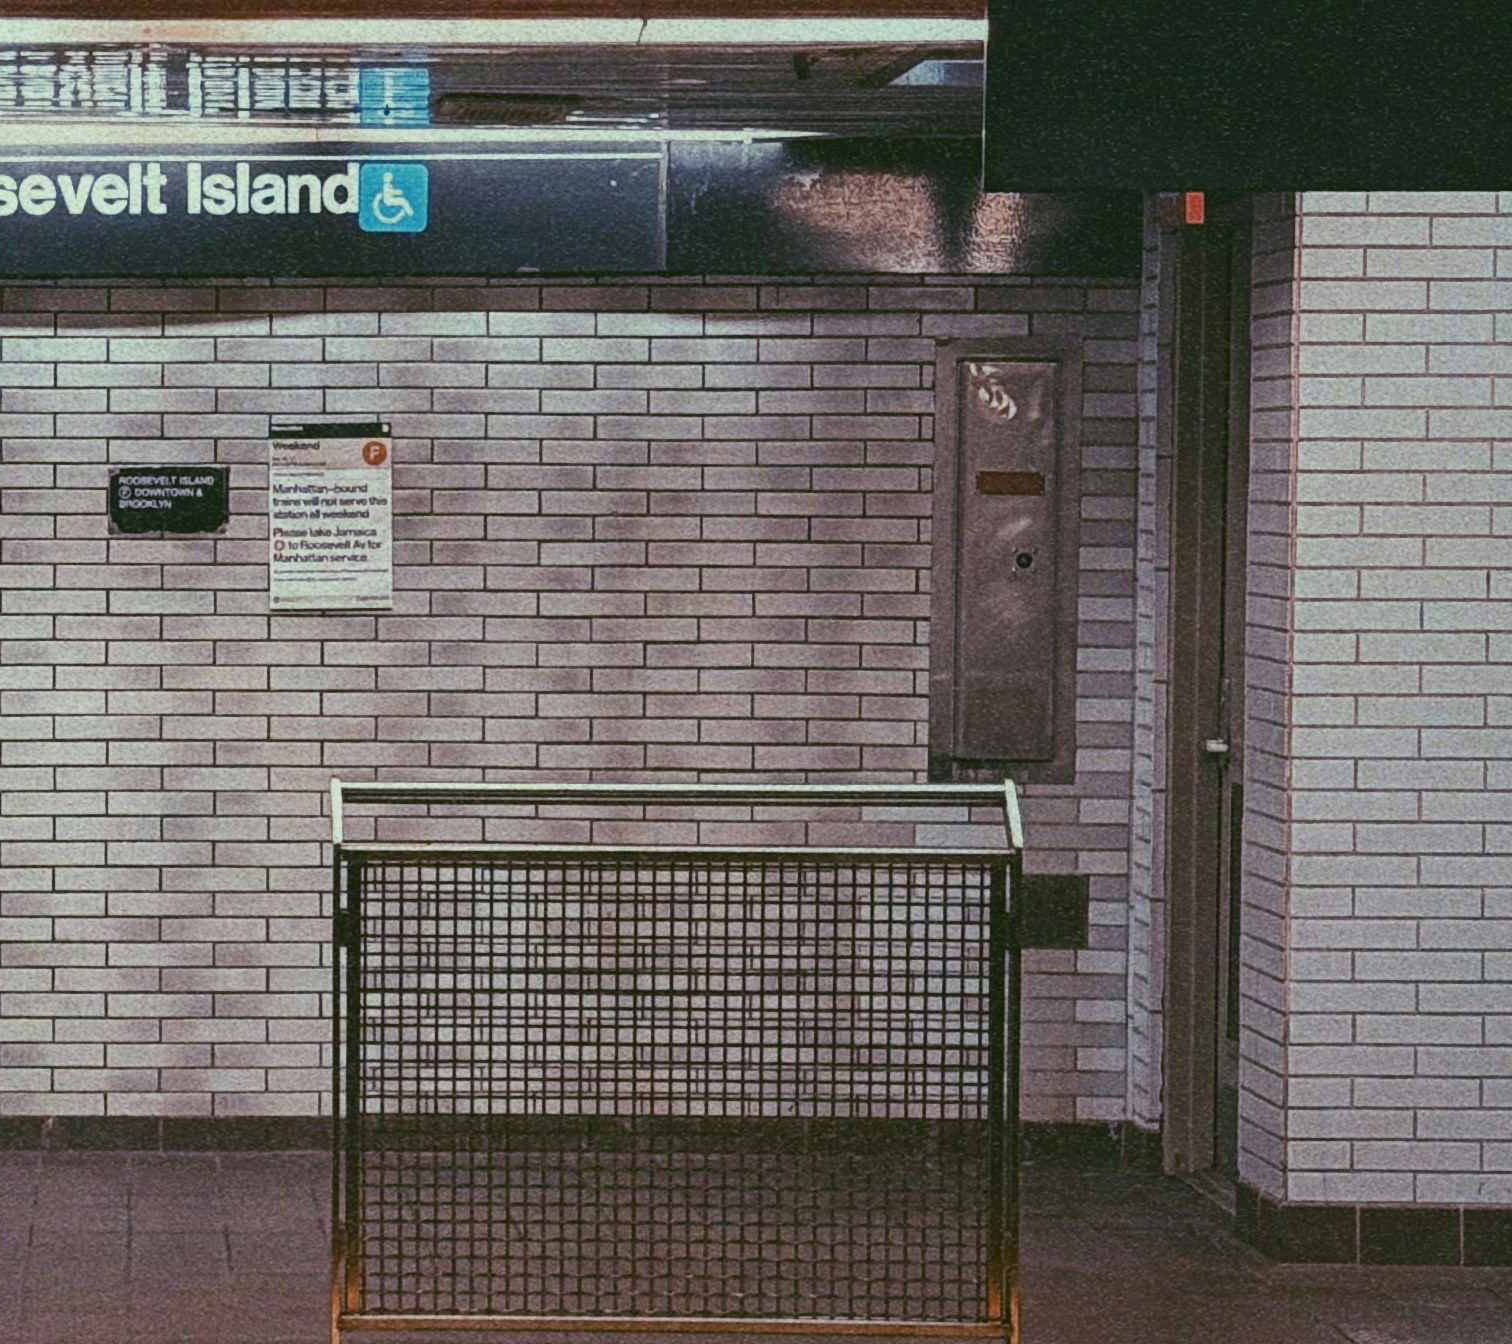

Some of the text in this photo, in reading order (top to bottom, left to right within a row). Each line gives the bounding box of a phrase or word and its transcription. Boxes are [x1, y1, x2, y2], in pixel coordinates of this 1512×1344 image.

[187, 161, 360, 215] Island
[272, 441, 321, 450] Weekend
[118, 476, 214, 486] ROOSEVELT ISLAND
[134, 488, 194, 497] DOWNTOWN
[118, 499, 172, 509] BROOKLYN
[273, 497, 301, 506] trains
[303, 496, 319, 506] will
[321, 497, 337, 506] not
[369, 496, 388, 506] this
[273, 509, 369, 519] station all weekend
[273, 527, 307, 537] Please
[333, 526, 377, 537] Jamaica
[288, 541, 299, 550] to
[300, 540, 351, 549] Roosevelt
[353, 540, 366, 549] Av
[273, 553, 368, 562] Manhattan service
